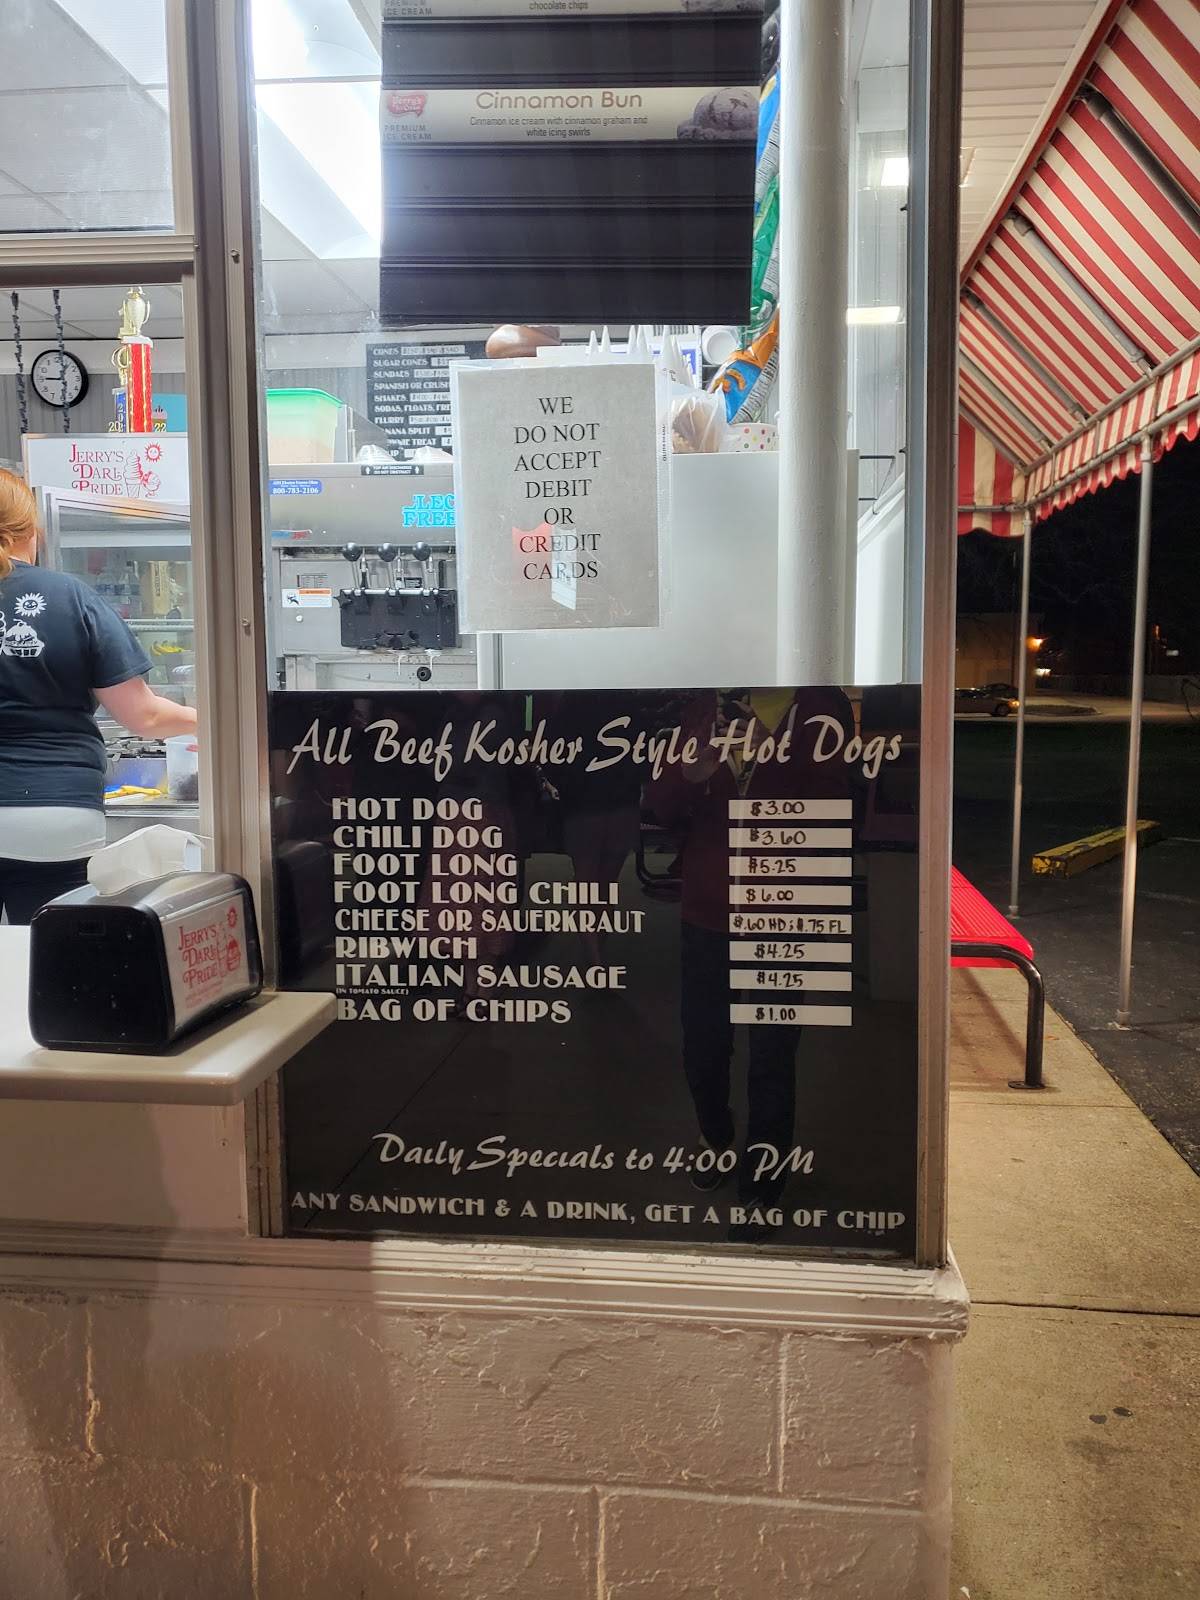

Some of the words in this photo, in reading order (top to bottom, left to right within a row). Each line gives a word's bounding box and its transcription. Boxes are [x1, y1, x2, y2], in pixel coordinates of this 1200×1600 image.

[529, 1, 566, 11] chocolate
[569, 1, 588, 11] chips
[476, 91, 593, 109] Cinnamon
[602, 91, 642, 108] Bun
[470, 116, 507, 125] Cinnamon
[522, 117, 545, 125] cream
[547, 116, 563, 125] with
[565, 116, 601, 125] cinnamon
[603, 116, 632, 126] graham
[634, 116, 648, 125] and
[527, 128, 547, 137] white
[549, 128, 566, 138] icing
[568, 128, 591, 137] swirls
[539, 396, 574, 414] WE
[514, 426, 547, 444] DO
[553, 423, 600, 442] NOT
[69, 443, 124, 463] JERRY'S
[514, 450, 602, 471] ACCEPT
[71, 480, 123, 496] PRIDE
[525, 479, 593, 498] DEBIT
[544, 507, 575, 525] OR
[519, 534, 602, 553] CREDIT
[523, 561, 599, 580] CARDS
[286, 718, 353, 775] All
[364, 718, 453, 782] Beef
[463, 719, 583, 765] Kosher
[585, 716, 698, 781] Style
[709, 717, 792, 763] Hot
[804, 714, 903, 779] Dogs
[332, 797, 401, 820] HOT
[413, 797, 483, 820] DOG
[750, 800, 805, 816] $3.00
[333, 825, 422, 848] CHILI
[433, 825, 503, 848] DOG
[750, 828, 806, 845] $3.60
[333, 853, 420, 876] FOOT
[431, 853, 518, 876] LONG
[748, 857, 797, 874] $5.25
[334, 881, 420, 903] FOOT
[431, 881, 518, 904] LONG
[529, 881, 619, 905] CHILI
[746, 888, 794, 903] $6.00
[335, 908, 430, 931] CHEESE
[438, 908, 473, 932] OR
[481, 910, 646, 933] SAUERKRAUT
[829, 919, 847, 933] FL
[335, 936, 477, 960] RIBWICH
[754, 943, 805, 959] $4.25
[335, 964, 464, 987] ITALIAN
[477, 965, 627, 989] SAUSAGE
[756, 971, 804, 988] $4.25
[337, 998, 401, 1021] BAG
[413, 998, 455, 1022] OF
[466, 999, 572, 1023] CHIPS
[755, 1007, 796, 1022] $1.00
[372, 1132, 463, 1175] Daily
[467, 1136, 615, 1178] Specials
[625, 1148, 653, 1170] to
[663, 1146, 737, 1174] 4:00
[747, 1142, 814, 1182] PM
[291, 1191, 340, 1211] ANY
[349, 1194, 485, 1216] SANDWICH
[494, 1199, 511, 1218] &
[520, 1200, 538, 1219] A
[547, 1201, 636, 1224] DRINK,
[644, 1204, 695, 1224] GET
[703, 1206, 720, 1224] A
[730, 1207, 783, 1227] BAG
[793, 1209, 828, 1228] OF
[837, 1210, 905, 1230] CHIP
